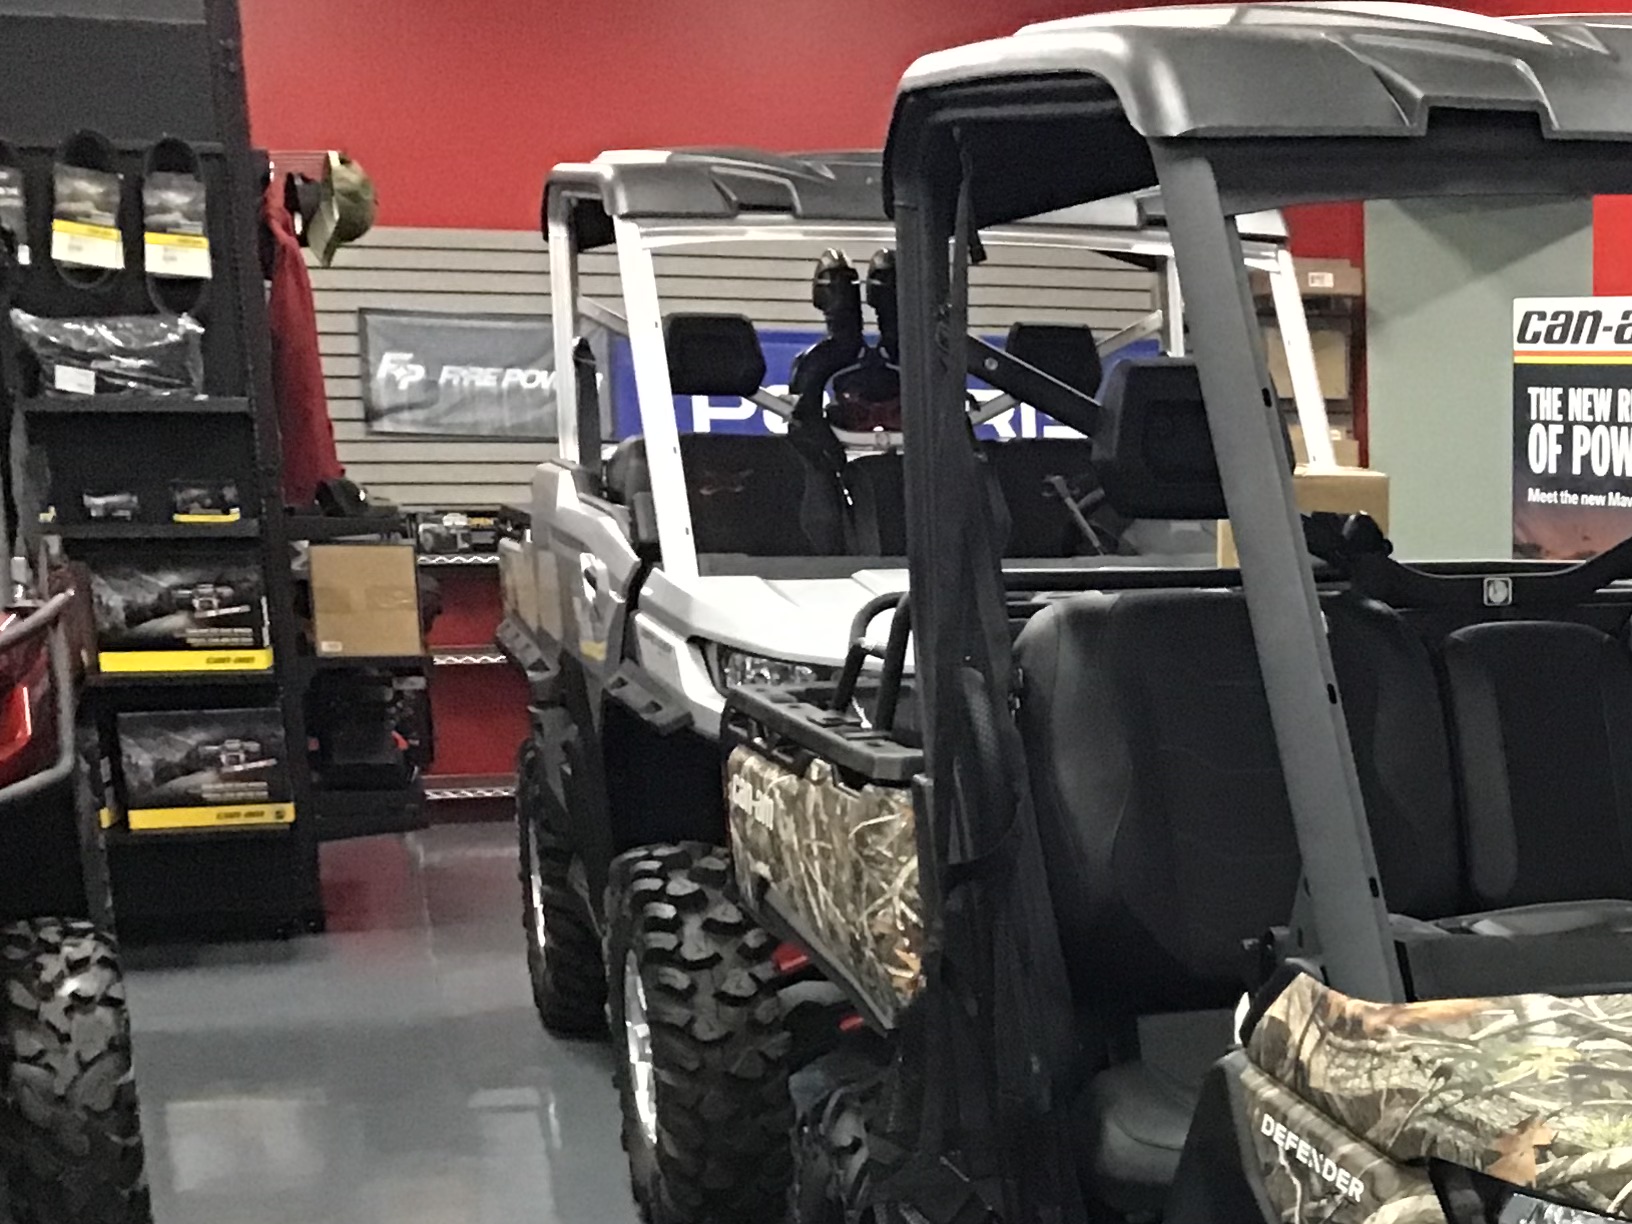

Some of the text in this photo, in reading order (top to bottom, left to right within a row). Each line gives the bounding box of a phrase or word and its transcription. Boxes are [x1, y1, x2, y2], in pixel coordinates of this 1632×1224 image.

[1527, 387, 1564, 421] THE
[1568, 387, 1613, 423] NEW
[1528, 423, 1565, 475] OF
[1528, 487, 1557, 503] Meet
[1559, 489, 1578, 505] the
[1580, 493, 1607, 507] new
[1260, 1113, 1364, 1202] DEFENDER
